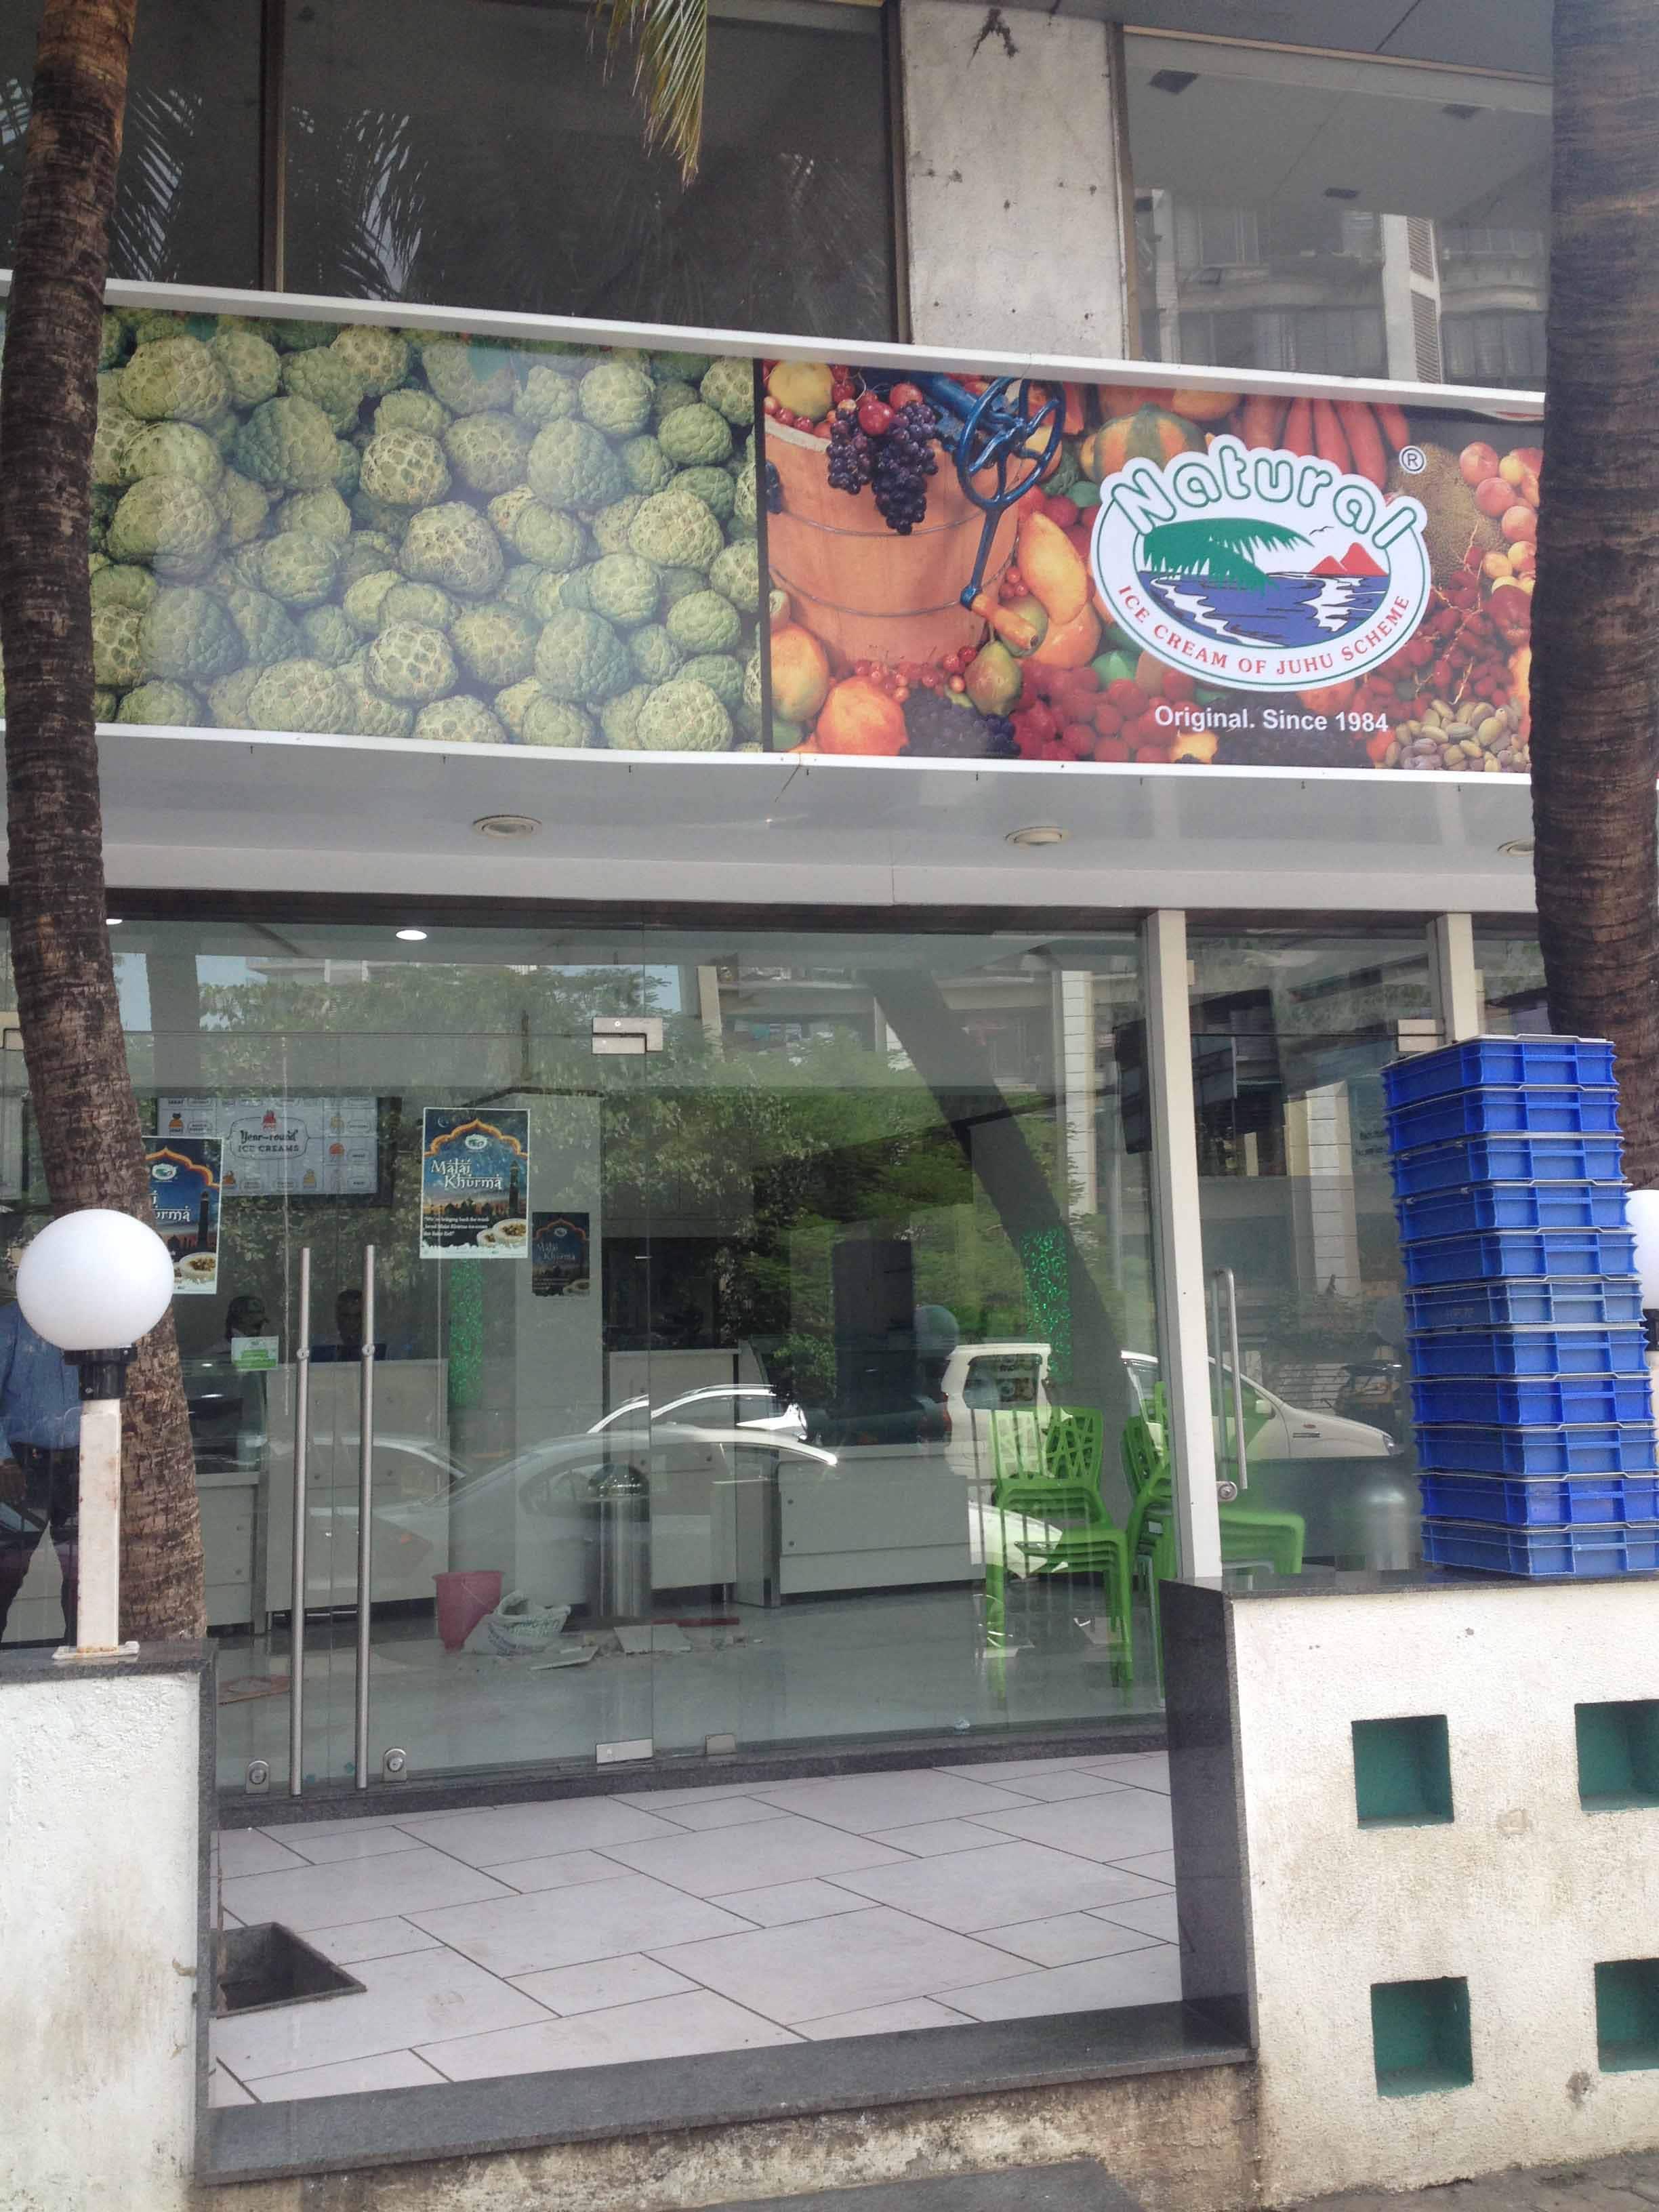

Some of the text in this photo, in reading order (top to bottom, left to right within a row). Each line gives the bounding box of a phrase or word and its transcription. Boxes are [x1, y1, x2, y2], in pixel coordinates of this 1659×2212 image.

[1111, 445, 1416, 549] Natural
[1118, 586, 1409, 675] ICE CREAM OF JUHU SCHEME
[1155, 705, 1389, 733] Original. Since 1984
[240, 1129, 298, 1144] Year-round
[258, 1145, 299, 1153] CREAMS
[431, 1158, 472, 1174] Malai
[445, 1173, 502, 1190] Khurma
